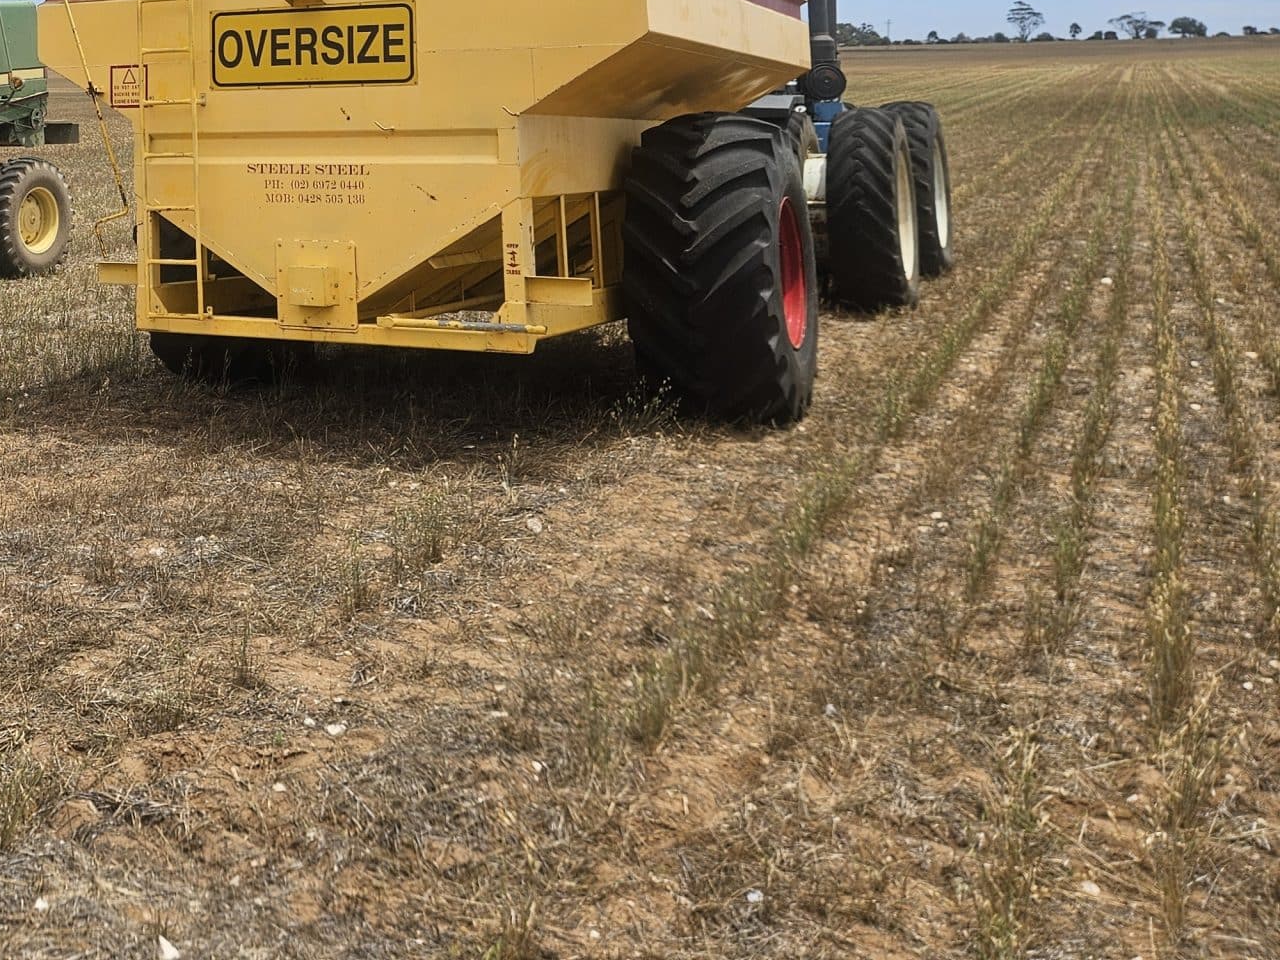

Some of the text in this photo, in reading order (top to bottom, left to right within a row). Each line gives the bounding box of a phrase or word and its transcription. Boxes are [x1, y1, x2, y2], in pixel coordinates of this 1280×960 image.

[218, 23, 406, 69] OVERSIZE
[246, 163, 370, 176] STEELE STEEL
[264, 179, 365, 191] PH: (02) 6972 0440
[265, 192, 295, 203] MOB:
[297, 193, 322, 204] 0428
[325, 193, 344, 204] 505
